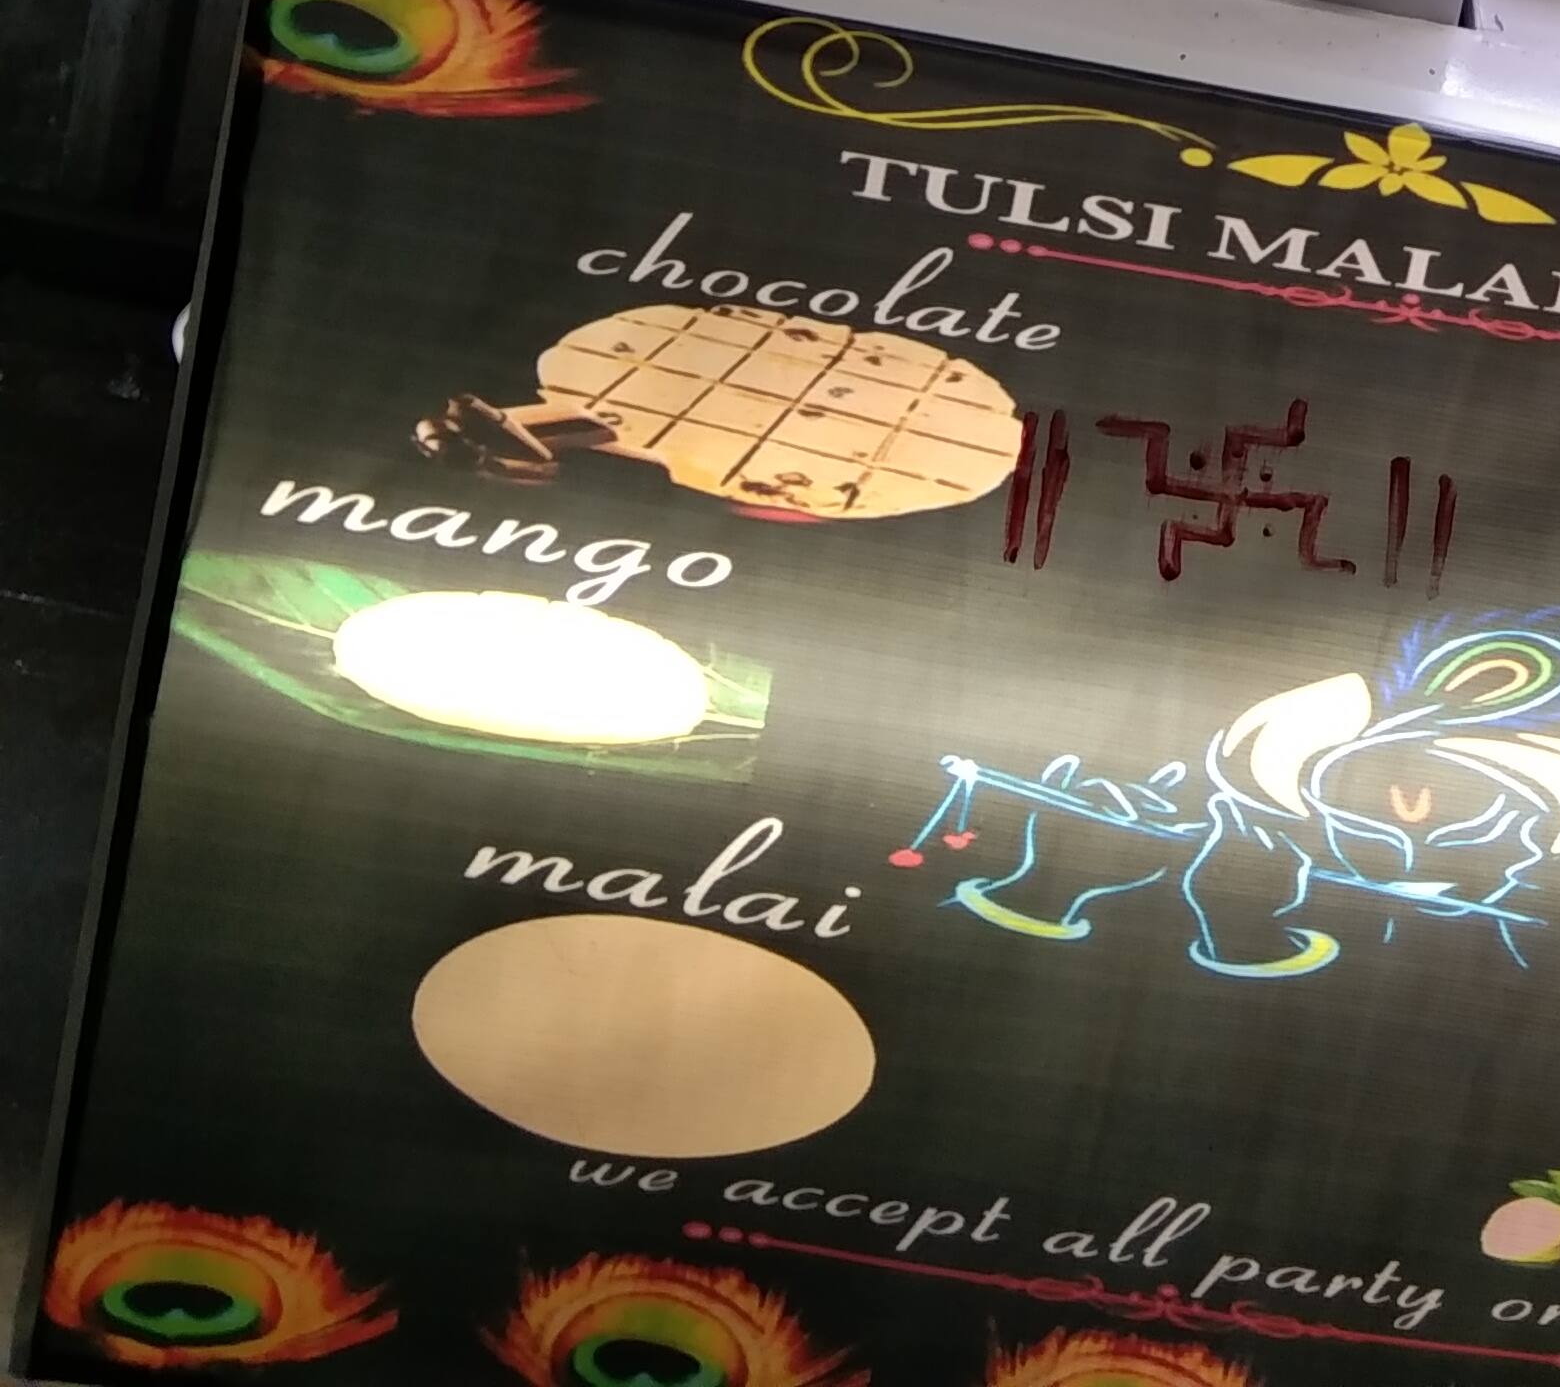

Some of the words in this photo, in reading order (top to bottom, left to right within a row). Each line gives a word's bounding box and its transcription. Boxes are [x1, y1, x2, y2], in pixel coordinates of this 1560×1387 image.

[840, 149, 1182, 251] TULSI
[576, 212, 1062, 352] chocolate
[259, 476, 734, 608] mango
[463, 816, 863, 940] malai
[568, 1157, 681, 1195] we
[722, 1173, 1012, 1252] accept
[1042, 1196, 1213, 1268] all
[1192, 1245, 1446, 1331] party
